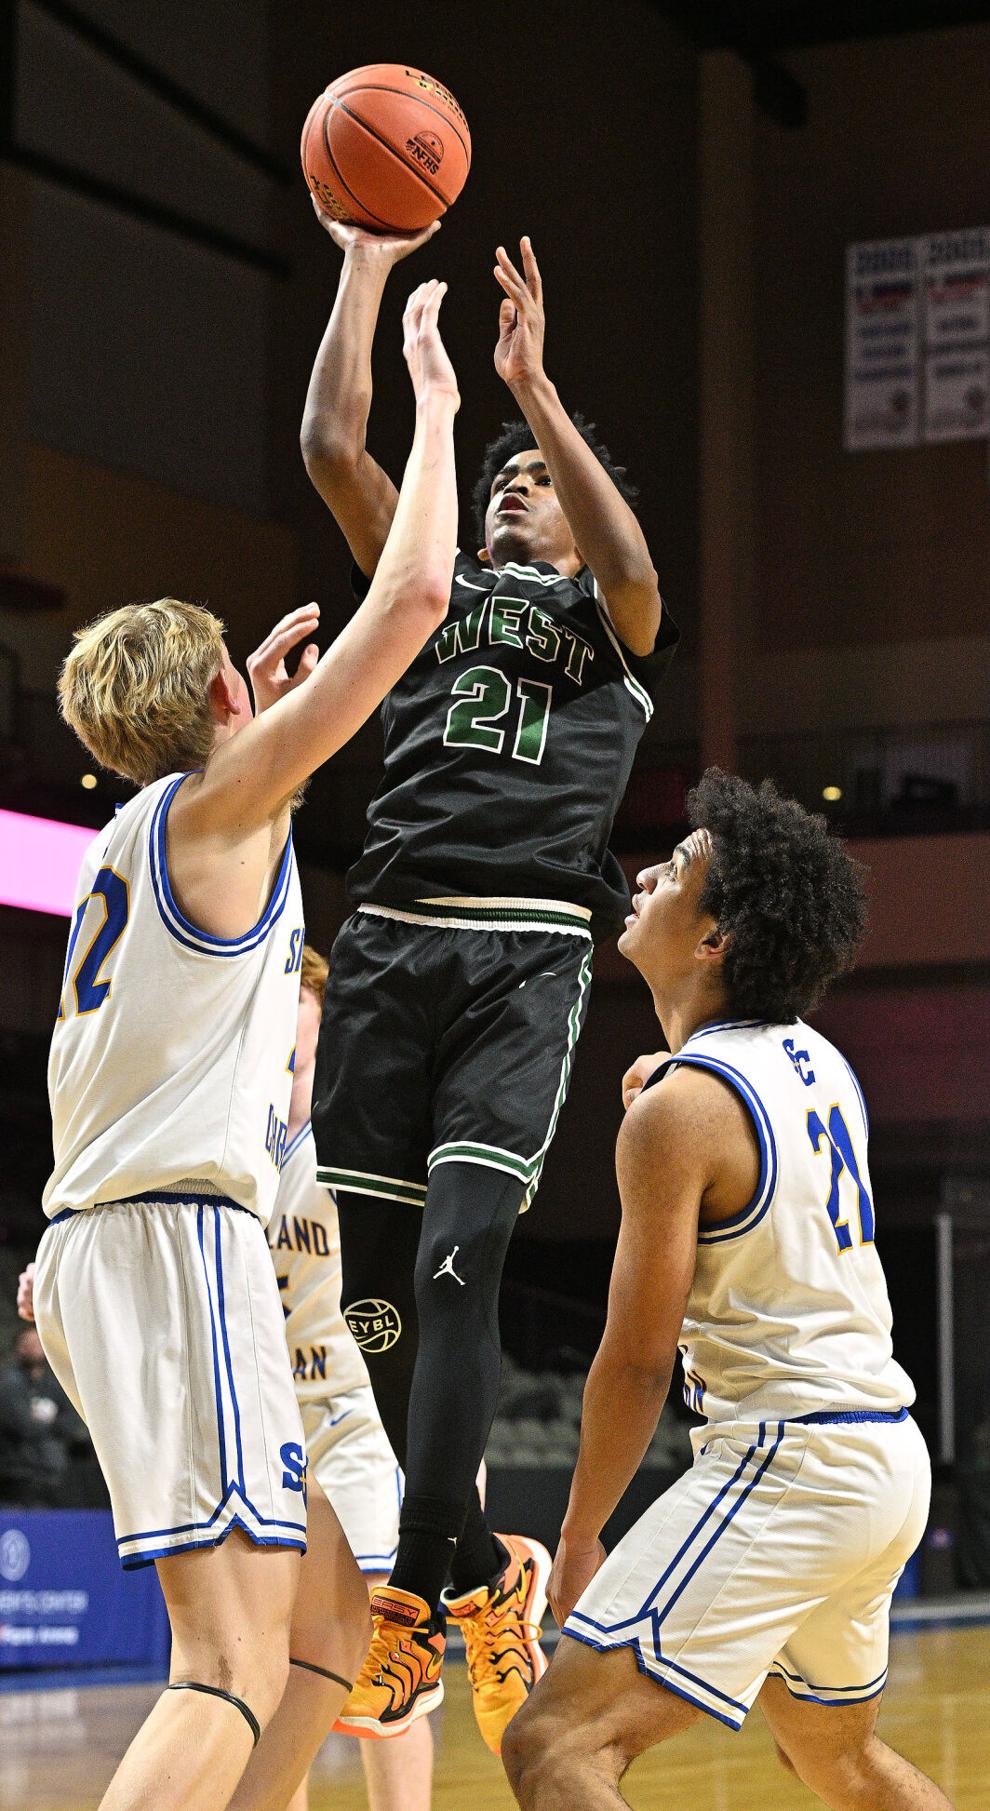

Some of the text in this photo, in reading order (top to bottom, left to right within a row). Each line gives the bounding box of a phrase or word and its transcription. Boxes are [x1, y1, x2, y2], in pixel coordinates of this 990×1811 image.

[411, 145, 440, 175] NFHS
[434, 596, 595, 686] WEST
[443, 665, 553, 765] 21
[782, 1038, 816, 1087] SC
[805, 1102, 875, 1257] 21
[268, 1214, 330, 1257] AND
[349, 1314, 395, 1334] EYBL
[372, 1596, 420, 1619] EASY
